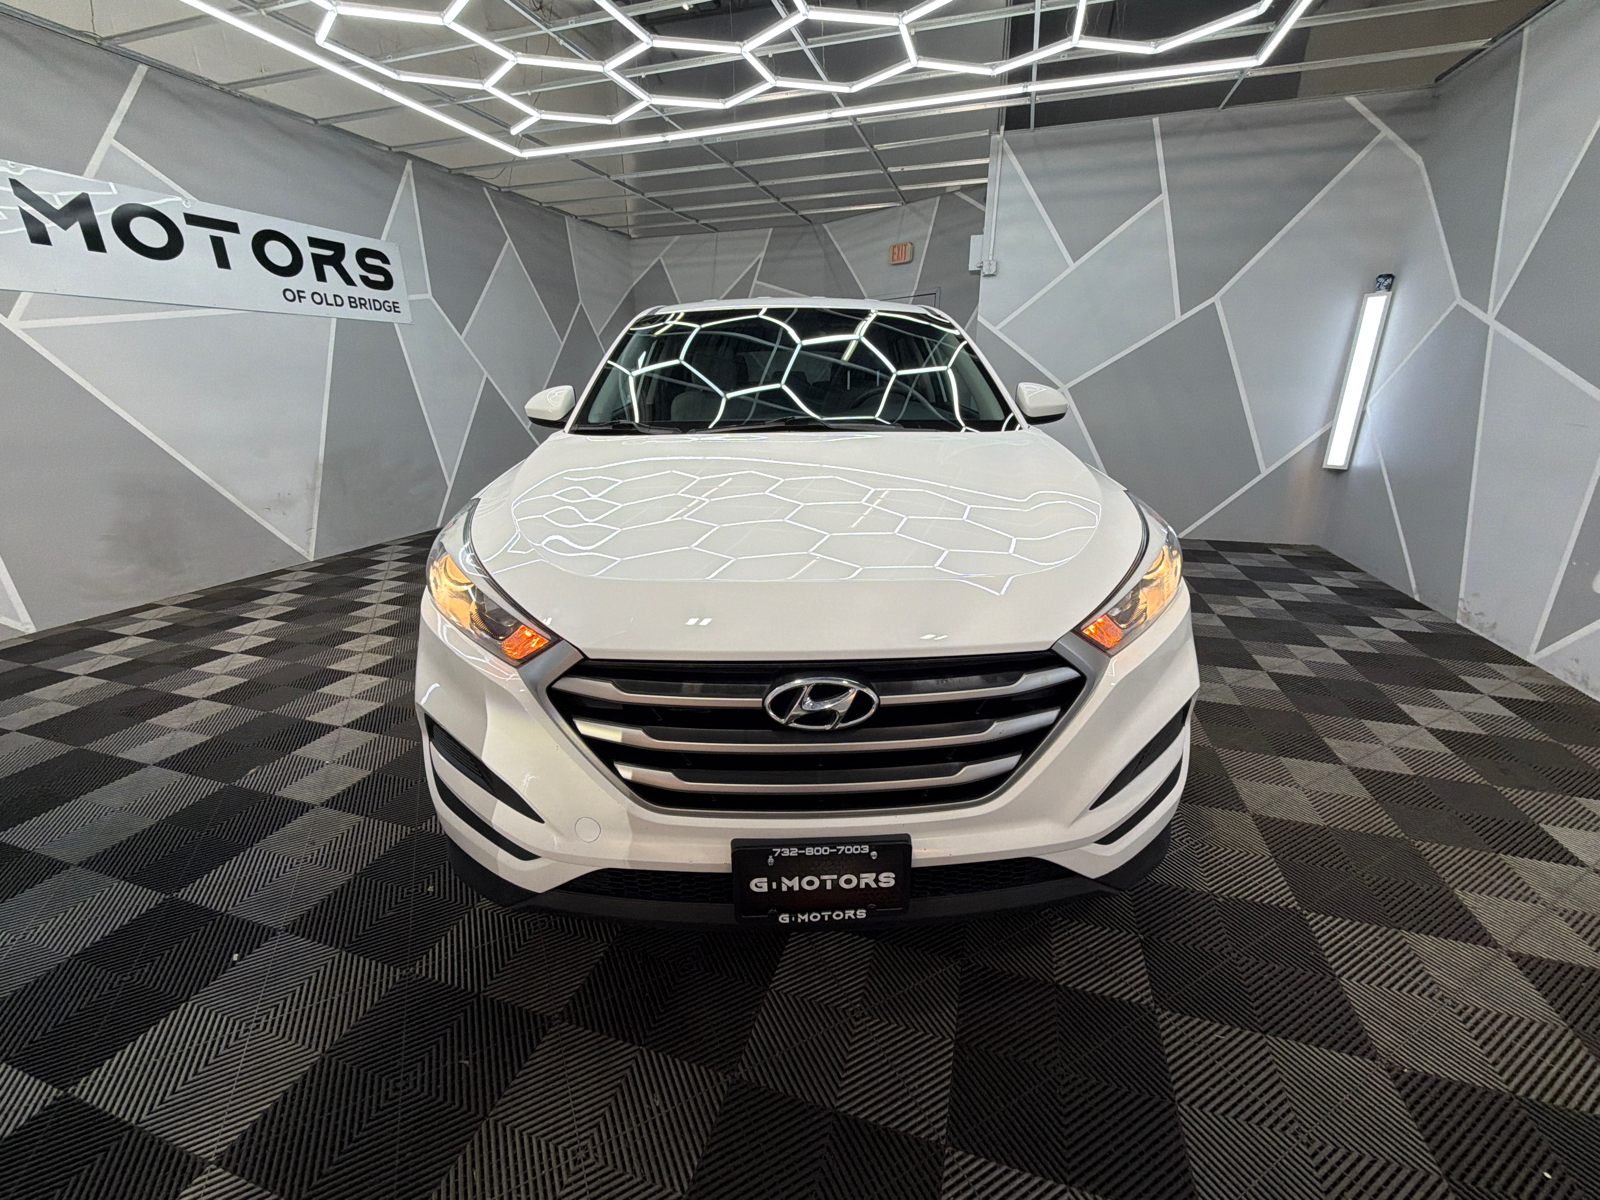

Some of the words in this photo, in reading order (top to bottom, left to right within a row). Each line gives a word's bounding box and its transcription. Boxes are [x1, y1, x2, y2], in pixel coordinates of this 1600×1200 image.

[8, 177, 394, 291] MOTORS
[891, 243, 908, 262] EXIT
[282, 288, 306, 303] OF
[310, 291, 344, 307] OLD
[347, 296, 401, 313] BRIDGE
[772, 845, 869, 856] 732-800-7003
